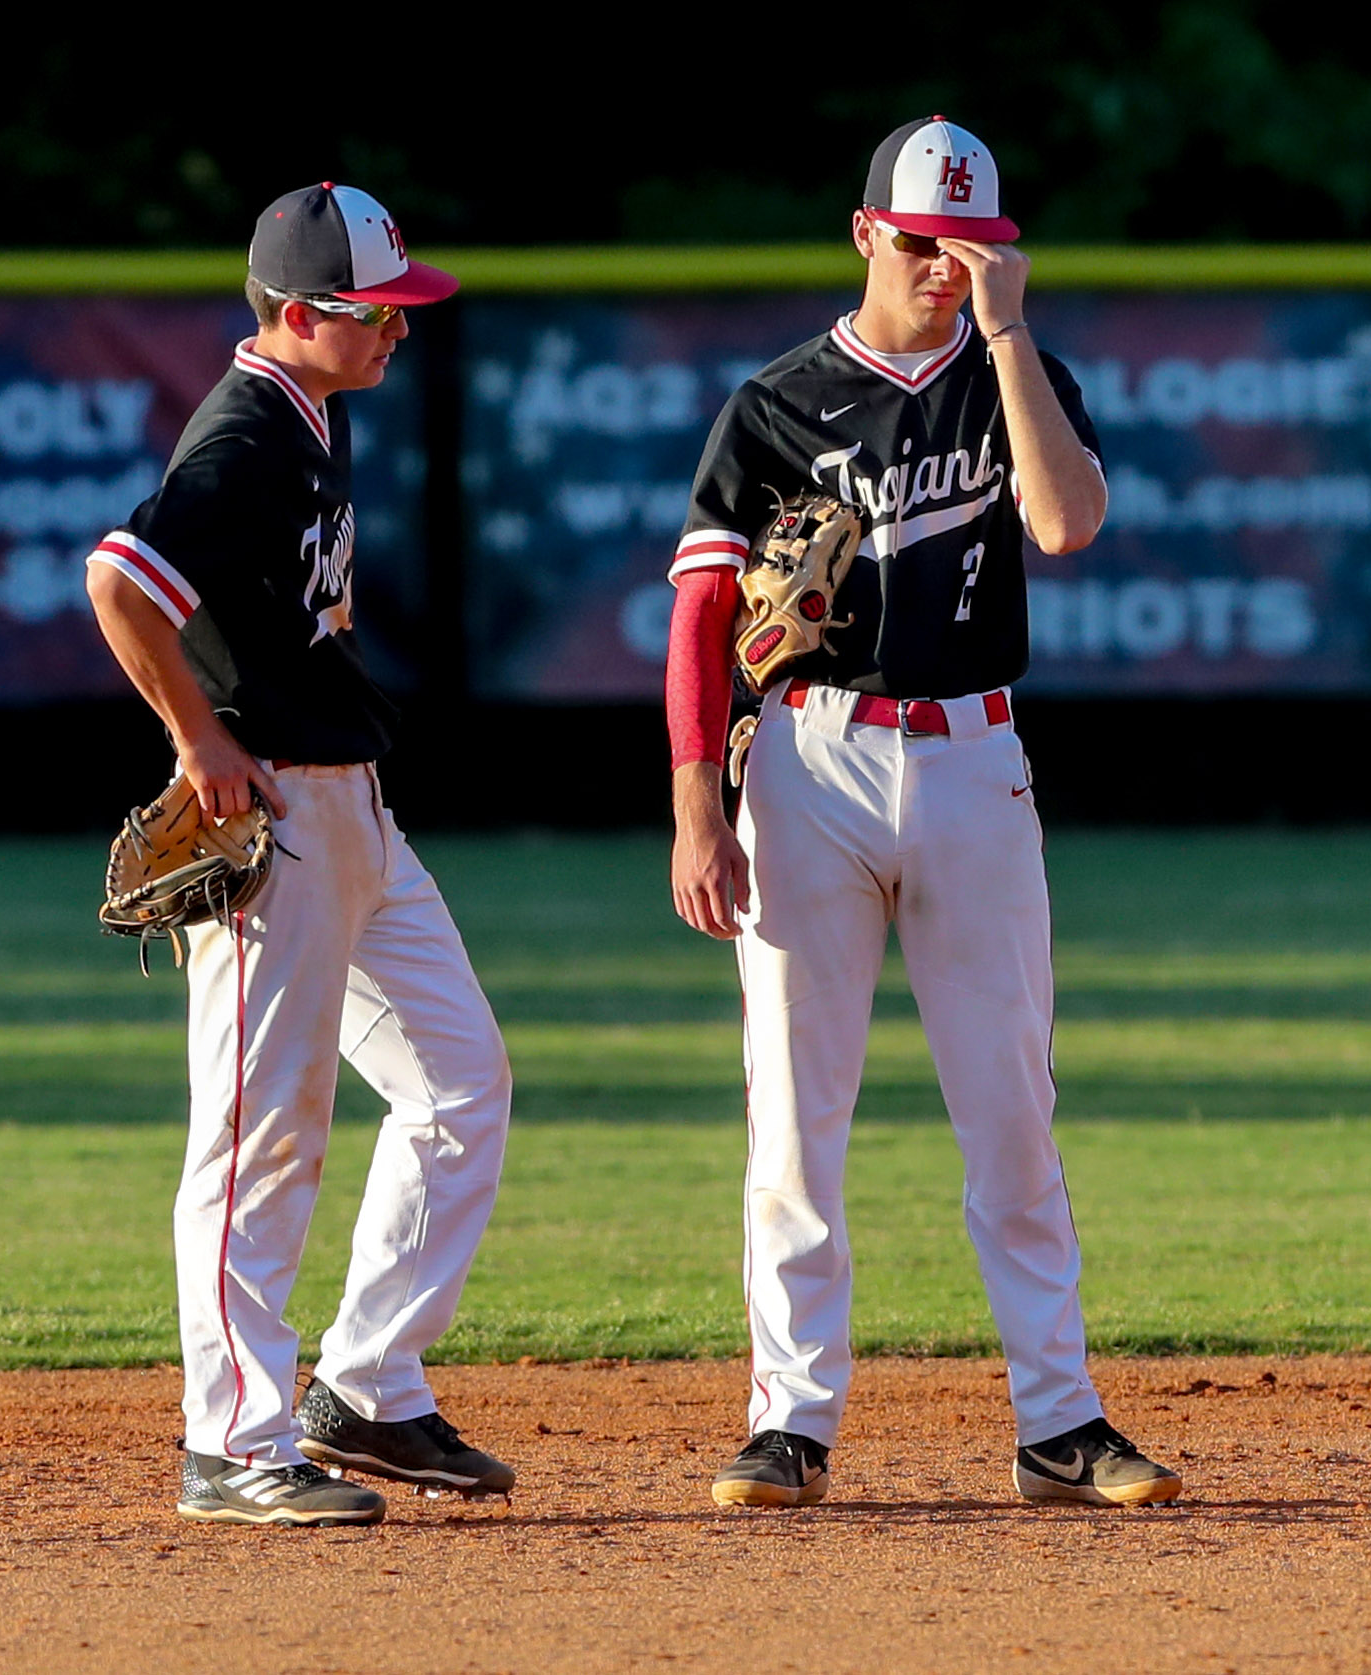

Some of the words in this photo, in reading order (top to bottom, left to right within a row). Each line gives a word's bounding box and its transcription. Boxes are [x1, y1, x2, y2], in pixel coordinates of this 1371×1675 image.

[810, 433, 1005, 548] Trojans
[953, 541, 986, 622] 2
[746, 630, 782, 665] Wilson
